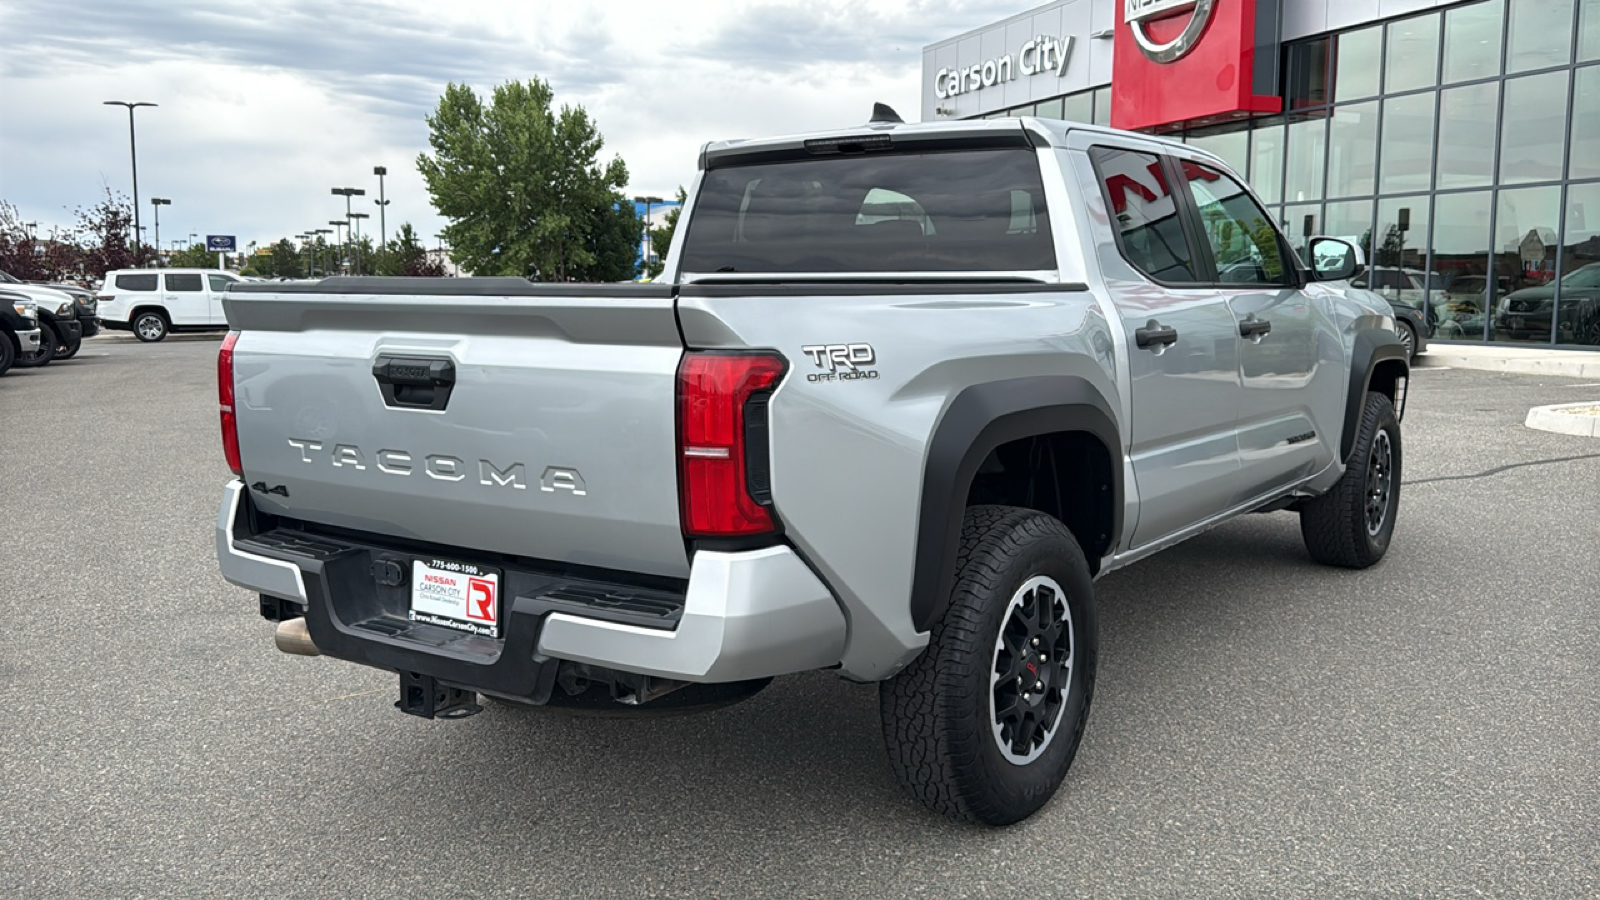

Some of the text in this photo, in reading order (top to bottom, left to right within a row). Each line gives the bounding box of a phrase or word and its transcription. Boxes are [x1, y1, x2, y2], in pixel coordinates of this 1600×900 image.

[935, 35, 1075, 100] Carson City
[801, 343, 876, 373] TRD
[390, 365, 428, 379] TOYOTA
[807, 370, 880, 382] OFF ROAD
[288, 438, 587, 496] TACOMA
[431, 560, 478, 575] 775-600-1500
[424, 574, 457, 586] NISSAN
[419, 582, 461, 597] CARSON CITY
